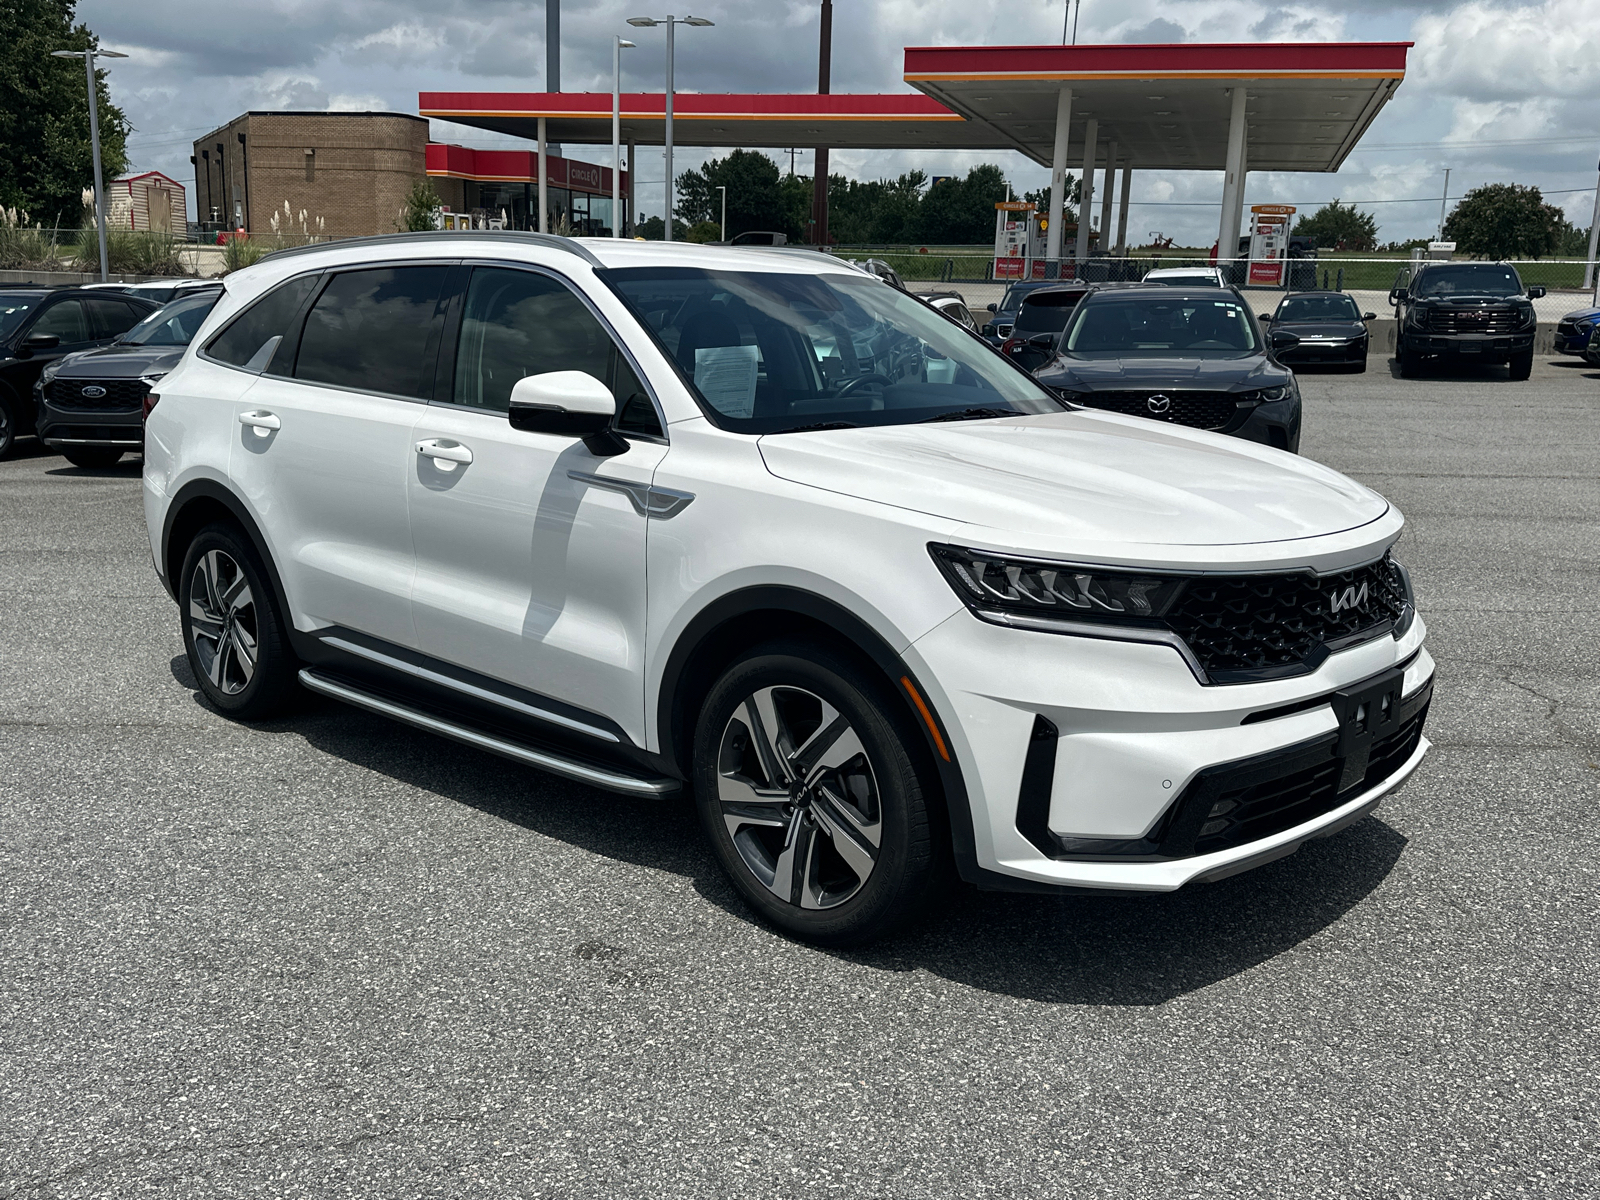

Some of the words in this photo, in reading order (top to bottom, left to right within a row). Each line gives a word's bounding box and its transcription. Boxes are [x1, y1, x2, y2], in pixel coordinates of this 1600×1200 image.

[571, 168, 590, 181] CIRCLE
[590, 169, 598, 185] K
[1330, 582, 1368, 614] KIA
